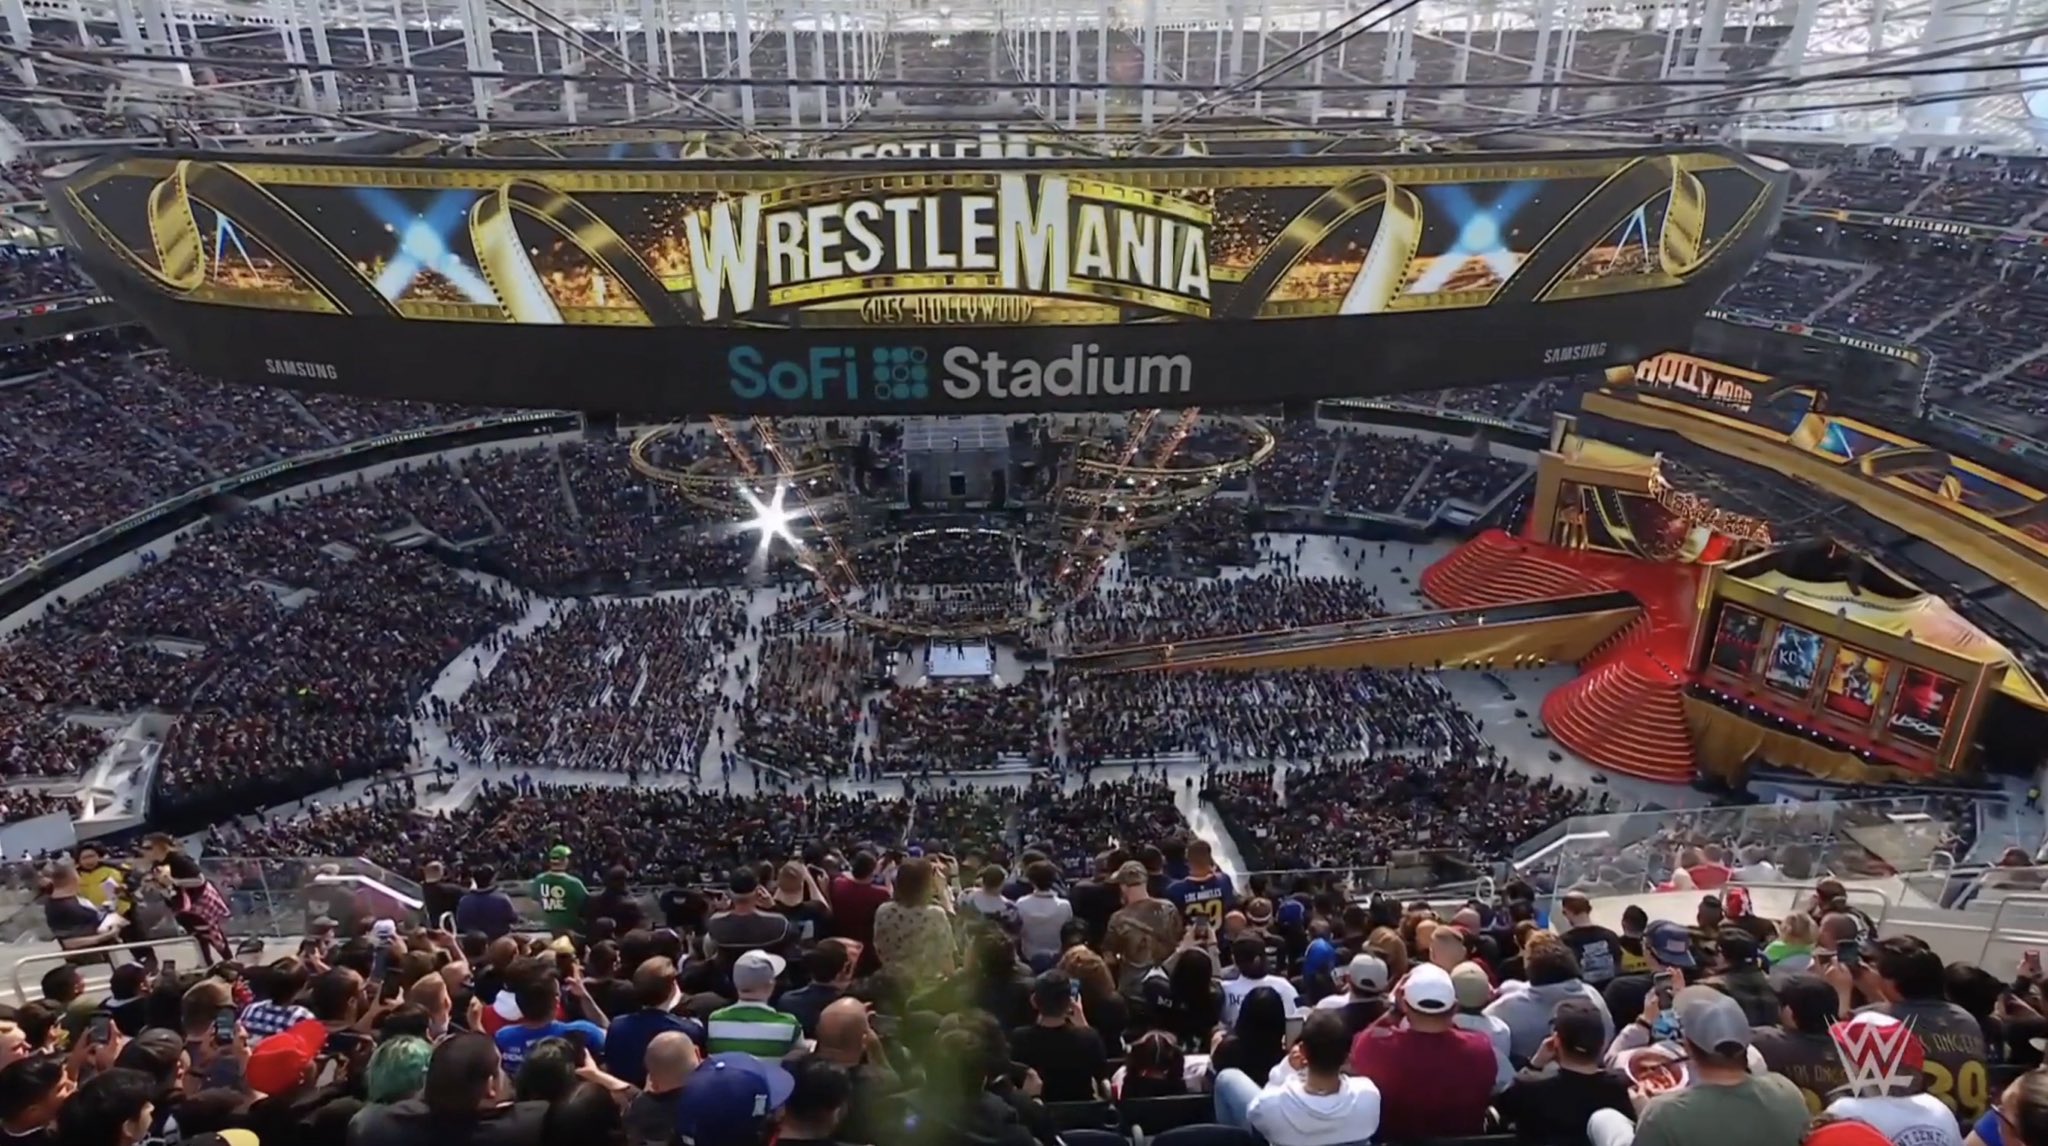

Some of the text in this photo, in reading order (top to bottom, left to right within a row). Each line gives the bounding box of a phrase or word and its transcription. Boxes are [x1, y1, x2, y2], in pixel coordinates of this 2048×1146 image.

[1543, 342, 1607, 363] SAMSUNG
[265, 359, 337, 379] SAMSUNG
[728, 344, 1191, 399] SoFi Stadium
